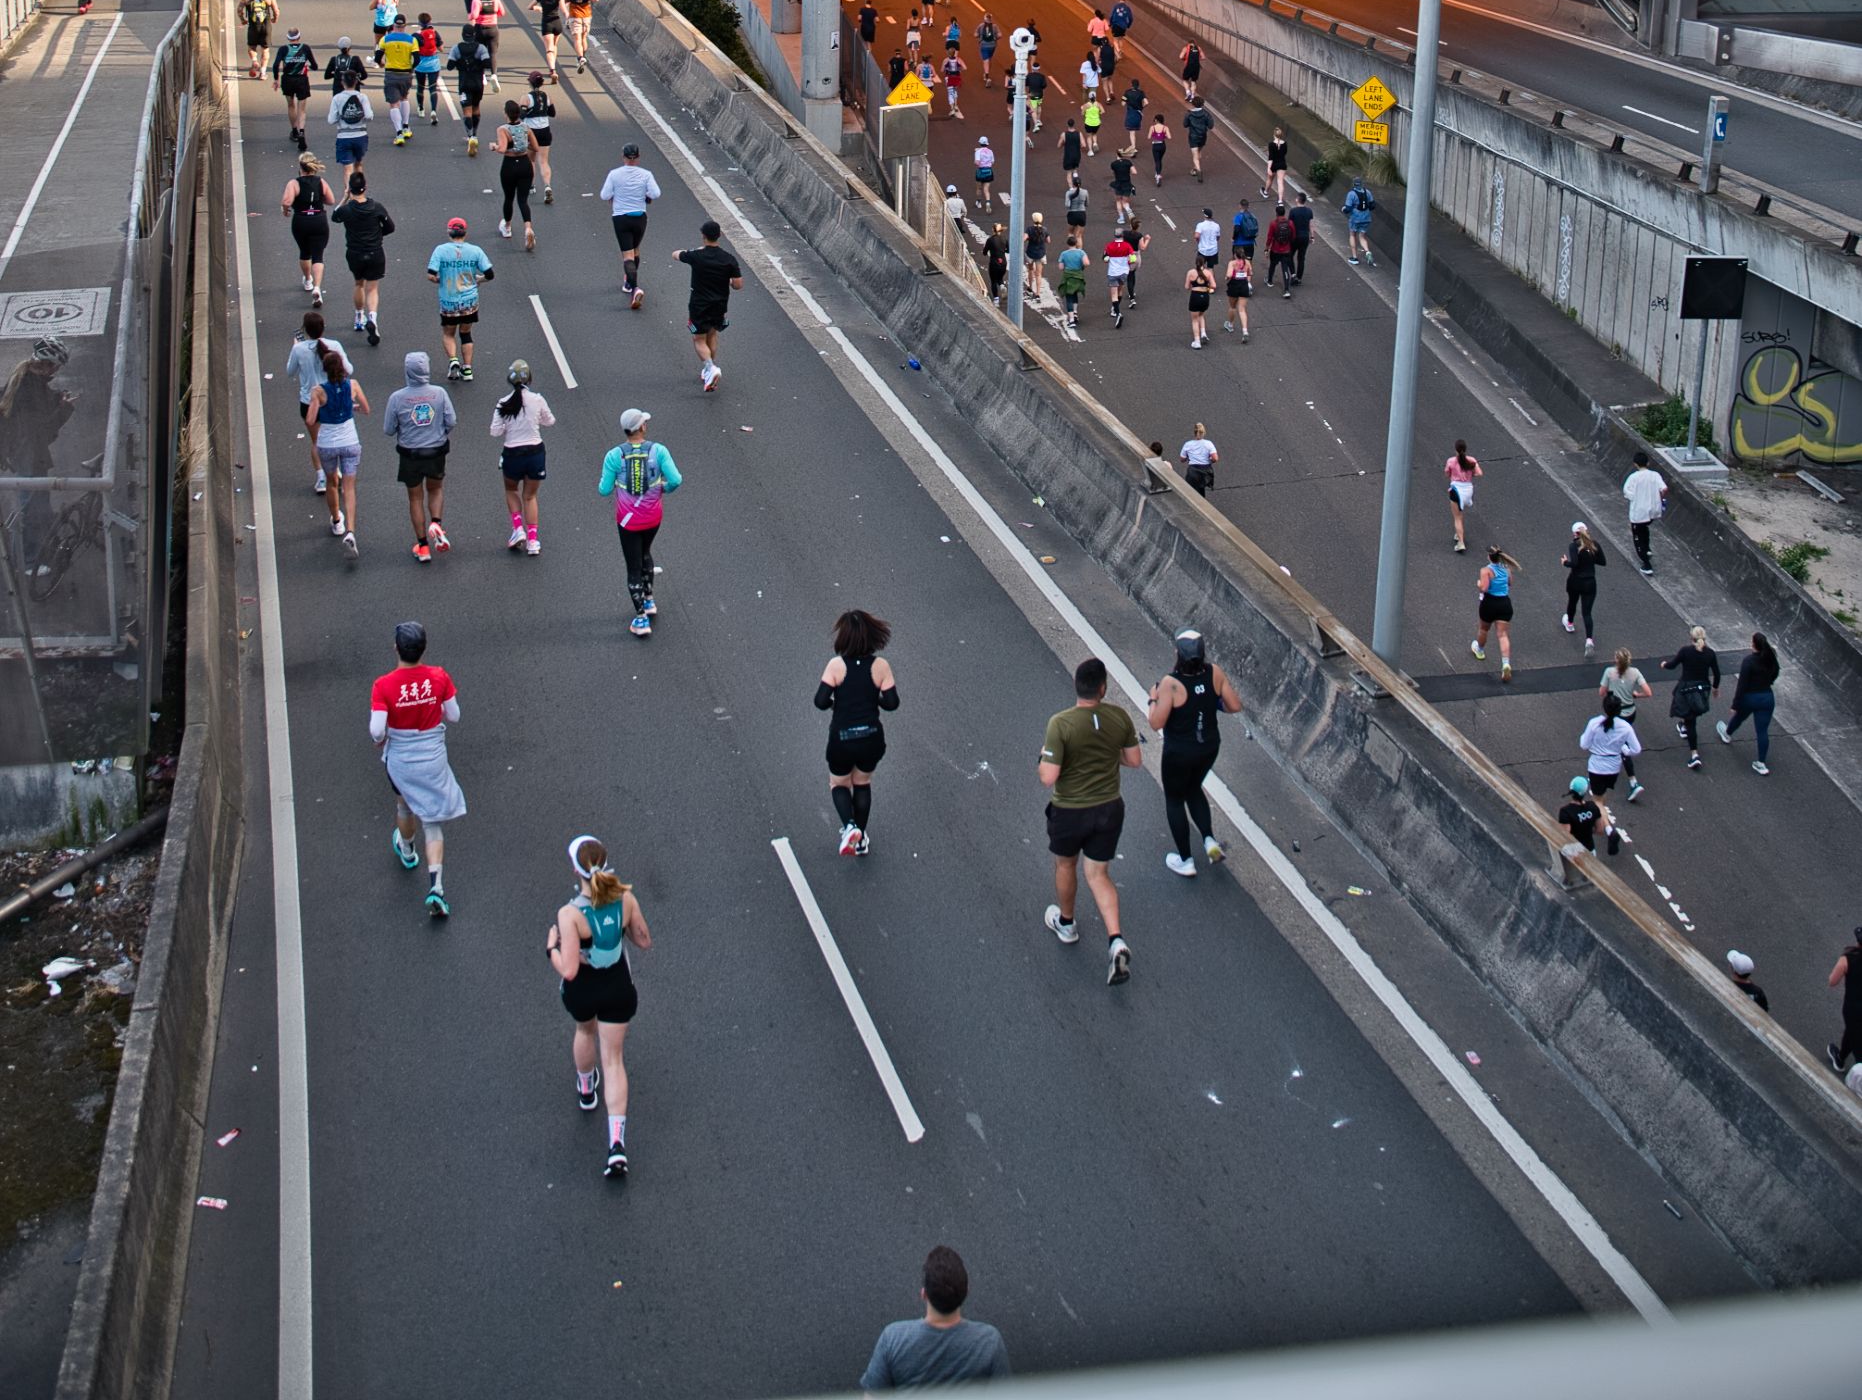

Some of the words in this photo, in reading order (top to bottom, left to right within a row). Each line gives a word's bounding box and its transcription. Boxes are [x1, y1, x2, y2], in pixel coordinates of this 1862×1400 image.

[901, 82, 919, 92] LEFT
[1364, 86, 1383, 94] LEFT
[900, 93, 920, 101] LANE
[1363, 94, 1384, 102] LANE
[1363, 102, 1384, 111] ENDS
[1360, 123, 1385, 132] MERGE
[1361, 129, 1383, 137] RIGHT
[1194, 684, 1206, 695] 03
